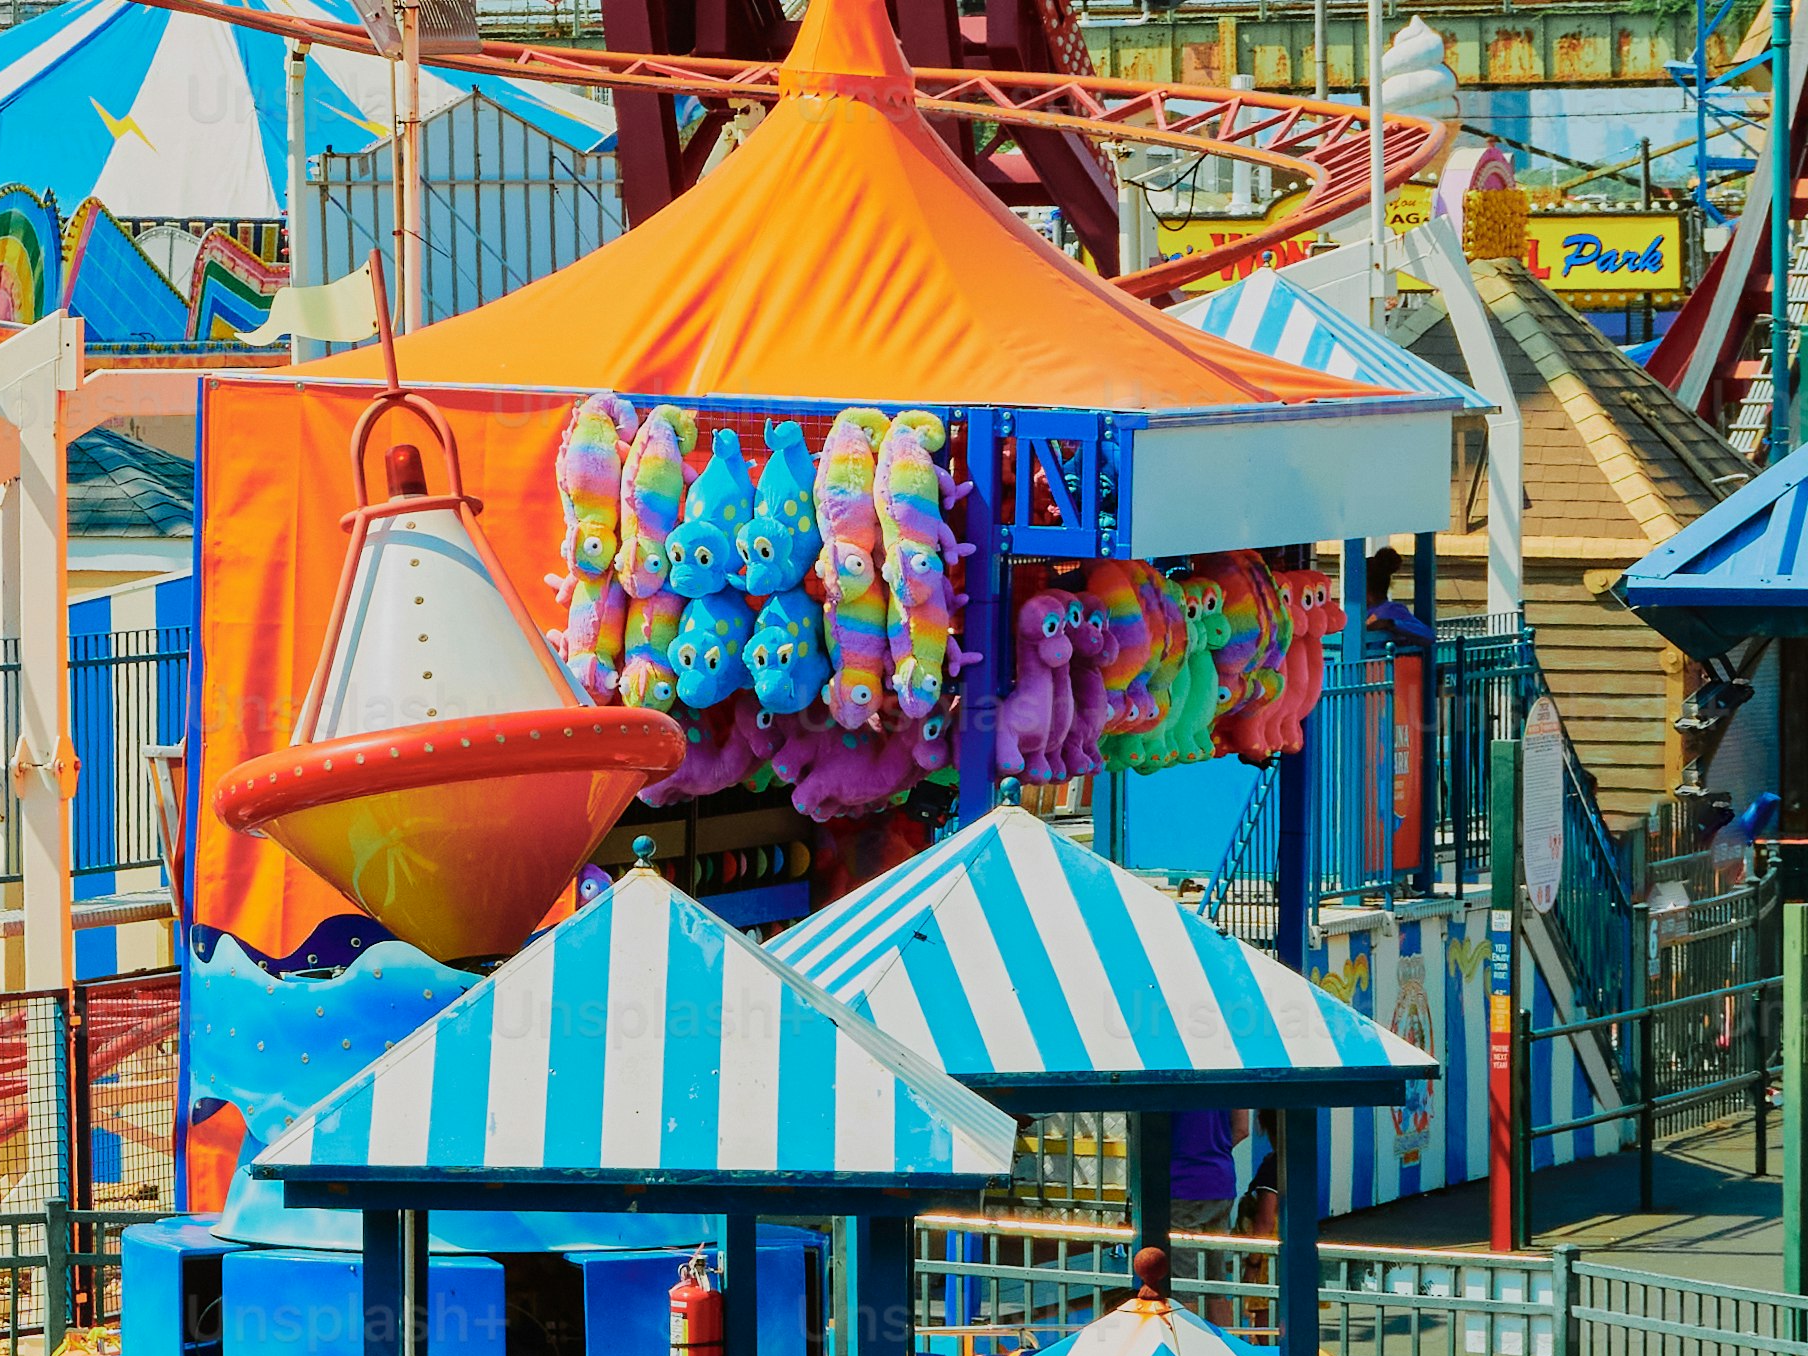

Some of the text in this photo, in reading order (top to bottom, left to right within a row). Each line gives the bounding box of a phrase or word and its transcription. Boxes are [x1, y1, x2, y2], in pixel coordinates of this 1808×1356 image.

[1562, 233, 1664, 277] Park
[1395, 725, 1409, 747] UNA
[1394, 752, 1409, 774] ARK
